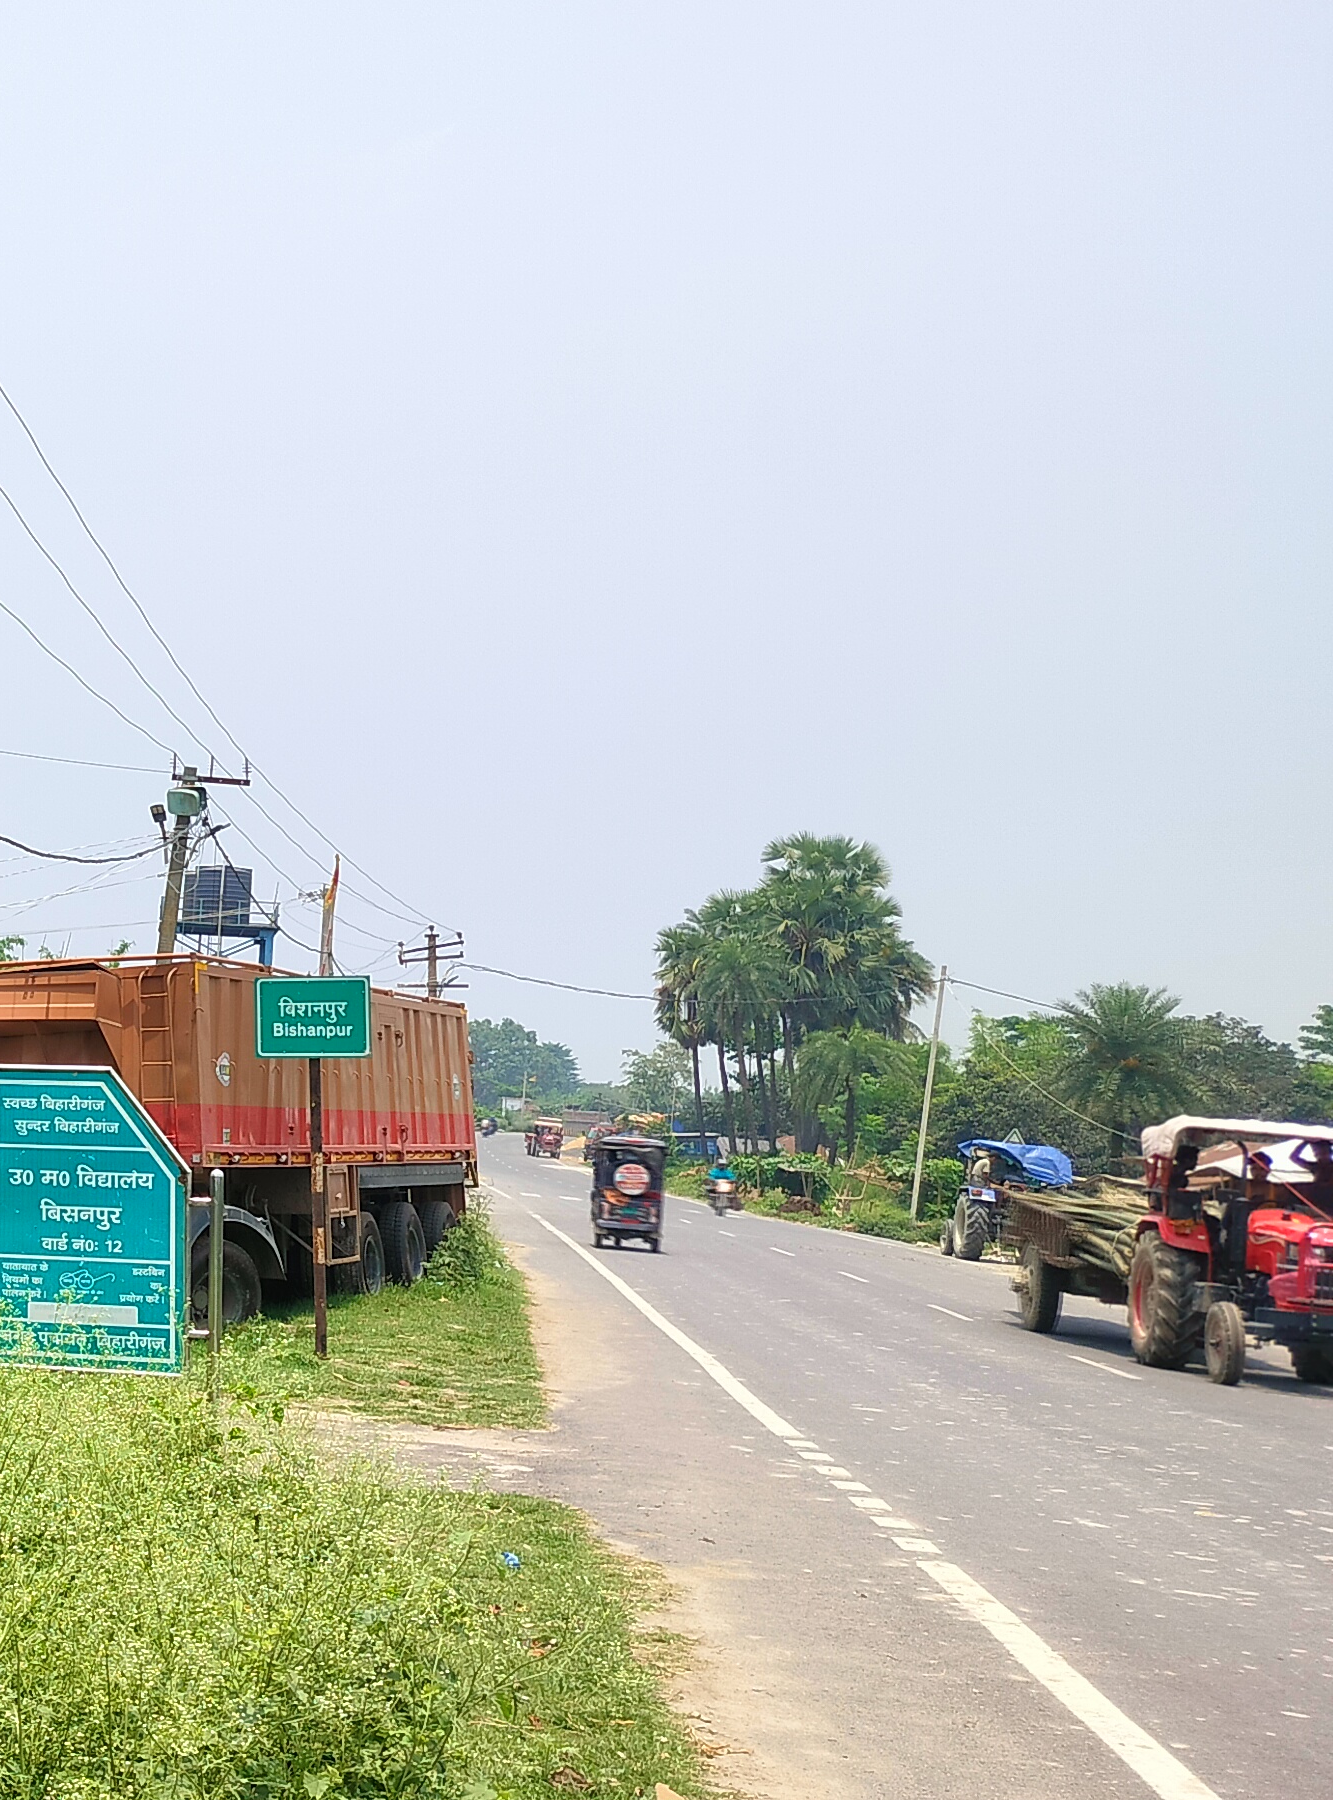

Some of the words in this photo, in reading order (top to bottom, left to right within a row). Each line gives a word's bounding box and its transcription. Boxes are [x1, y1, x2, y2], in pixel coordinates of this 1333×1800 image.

[278, 996, 348, 1023] बिशनपुर
[273, 1022, 353, 1039] Bishanpur
[2, 1097, 38, 1109] स्वच्छ
[40, 1094, 106, 1111] बिहारीगंज
[13, 1119, 51, 1136] सुन्दर
[54, 1116, 120, 1134] बिहारीगंज
[76, 1164, 154, 1189] विद्यालय
[39, 1197, 122, 1231] बिसनपुर
[41, 1232, 68, 1251] वार्ड
[105, 1239, 123, 1253] 12
